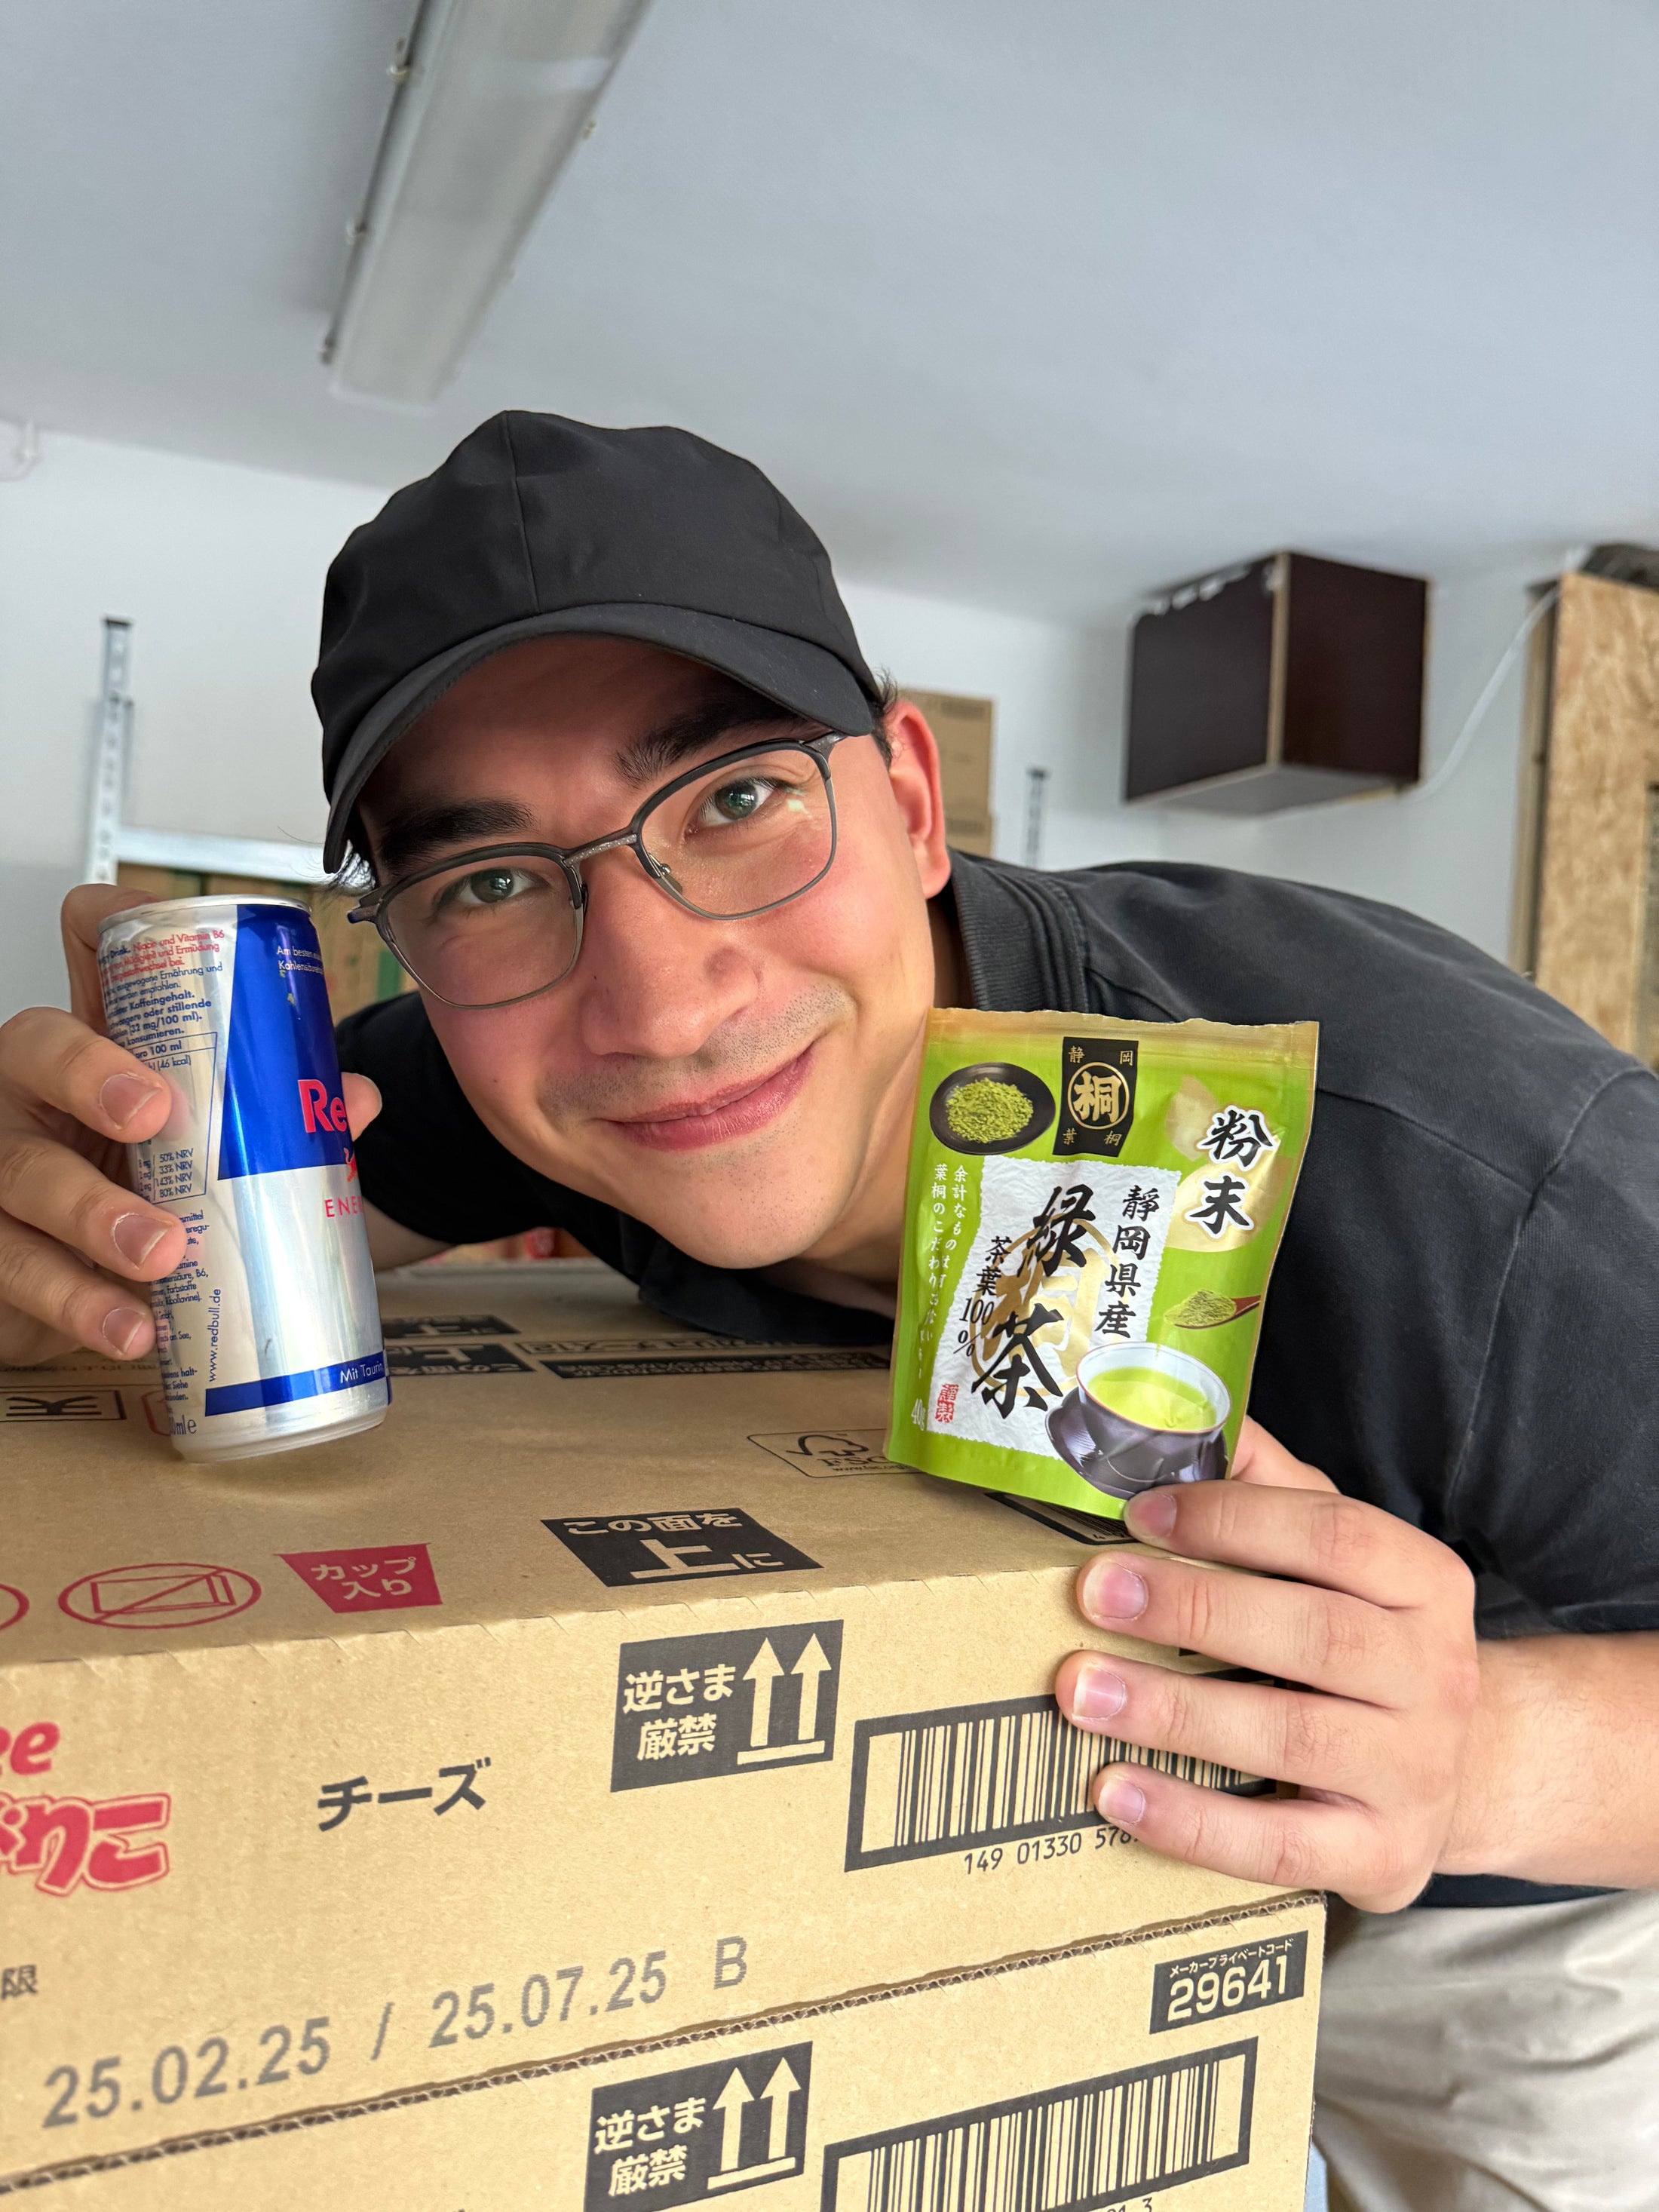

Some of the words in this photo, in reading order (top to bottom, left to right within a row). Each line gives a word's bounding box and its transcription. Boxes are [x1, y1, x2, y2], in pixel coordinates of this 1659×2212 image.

[213, 929, 225, 940] B6
[277, 946, 291, 956] Am
[160, 966, 204, 980] Ernährung
[206, 962, 223, 972] und
[130, 989, 195, 1010] Koffeingehalt.
[143, 1007, 164, 1019] oder
[167, 999, 212, 1013] stillende
[127, 1027, 185, 1045] konsumieren.
[151, 1044, 167, 1056] 100
[170, 1040, 182, 1051] ml
[298, 1079, 347, 1134] Re
[1072, 1070, 1122, 1124] 桐
[175, 1160, 193, 1172] NRV
[176, 1148, 193, 1160] NRV
[175, 1171, 192, 1184] NRV
[1189, 1109, 1273, 1235] 粉末
[175, 1183, 192, 1196] NRV
[186, 1224, 210, 1235] eregu-
[207, 1288, 222, 1382] www.redbull.de
[340, 1367, 358, 1384] Mit
[563, 1512, 744, 1535] この面を
[311, 1556, 417, 1582] カップ
[630, 1538, 785, 1579] 上に
[342, 1578, 412, 1600] 入り
[622, 1664, 737, 1714] 逆さま
[0, 1721, 60, 1776] e
[636, 1713, 717, 1762] 厳禁
[317, 1757, 492, 1833] チーズ
[964, 1848, 1003, 1875] 149
[1017, 1833, 1082, 1865] 01330
[1170, 1937, 1295, 1978] メーカープライベートコード
[1167, 1954, 1287, 2022] 29641
[42, 2016, 331, 2128] 25.02.25
[370, 2002, 394, 2062] /
[428, 1950, 667, 2048] 25.07.25
[713, 1935, 747, 1990] B
[593, 2097, 707, 2155] 逆さま
[608, 2143, 688, 2198] 厳禁
